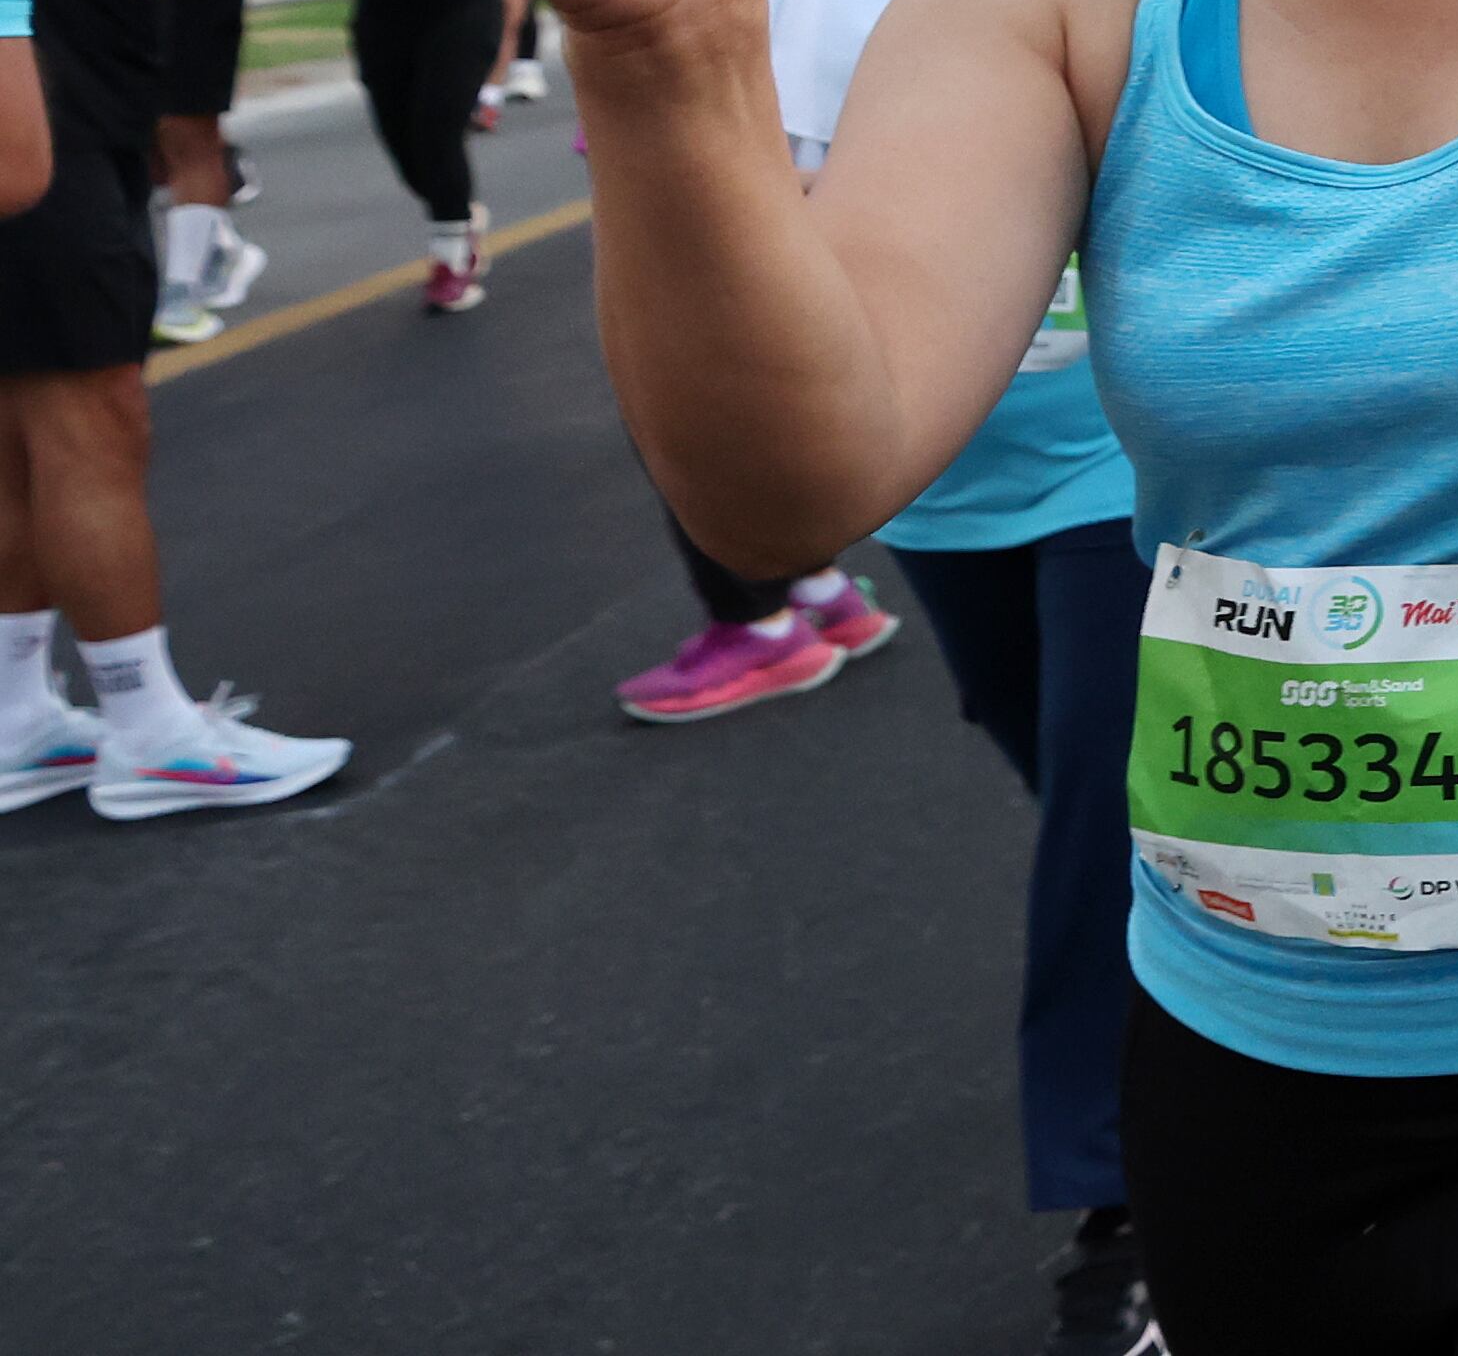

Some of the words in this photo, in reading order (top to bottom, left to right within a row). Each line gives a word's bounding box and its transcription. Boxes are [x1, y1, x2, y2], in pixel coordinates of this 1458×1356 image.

[1214, 598, 1294, 642] RUN
[1401, 597, 1453, 627] Mai
[1420, 880, 1451, 895] DP
